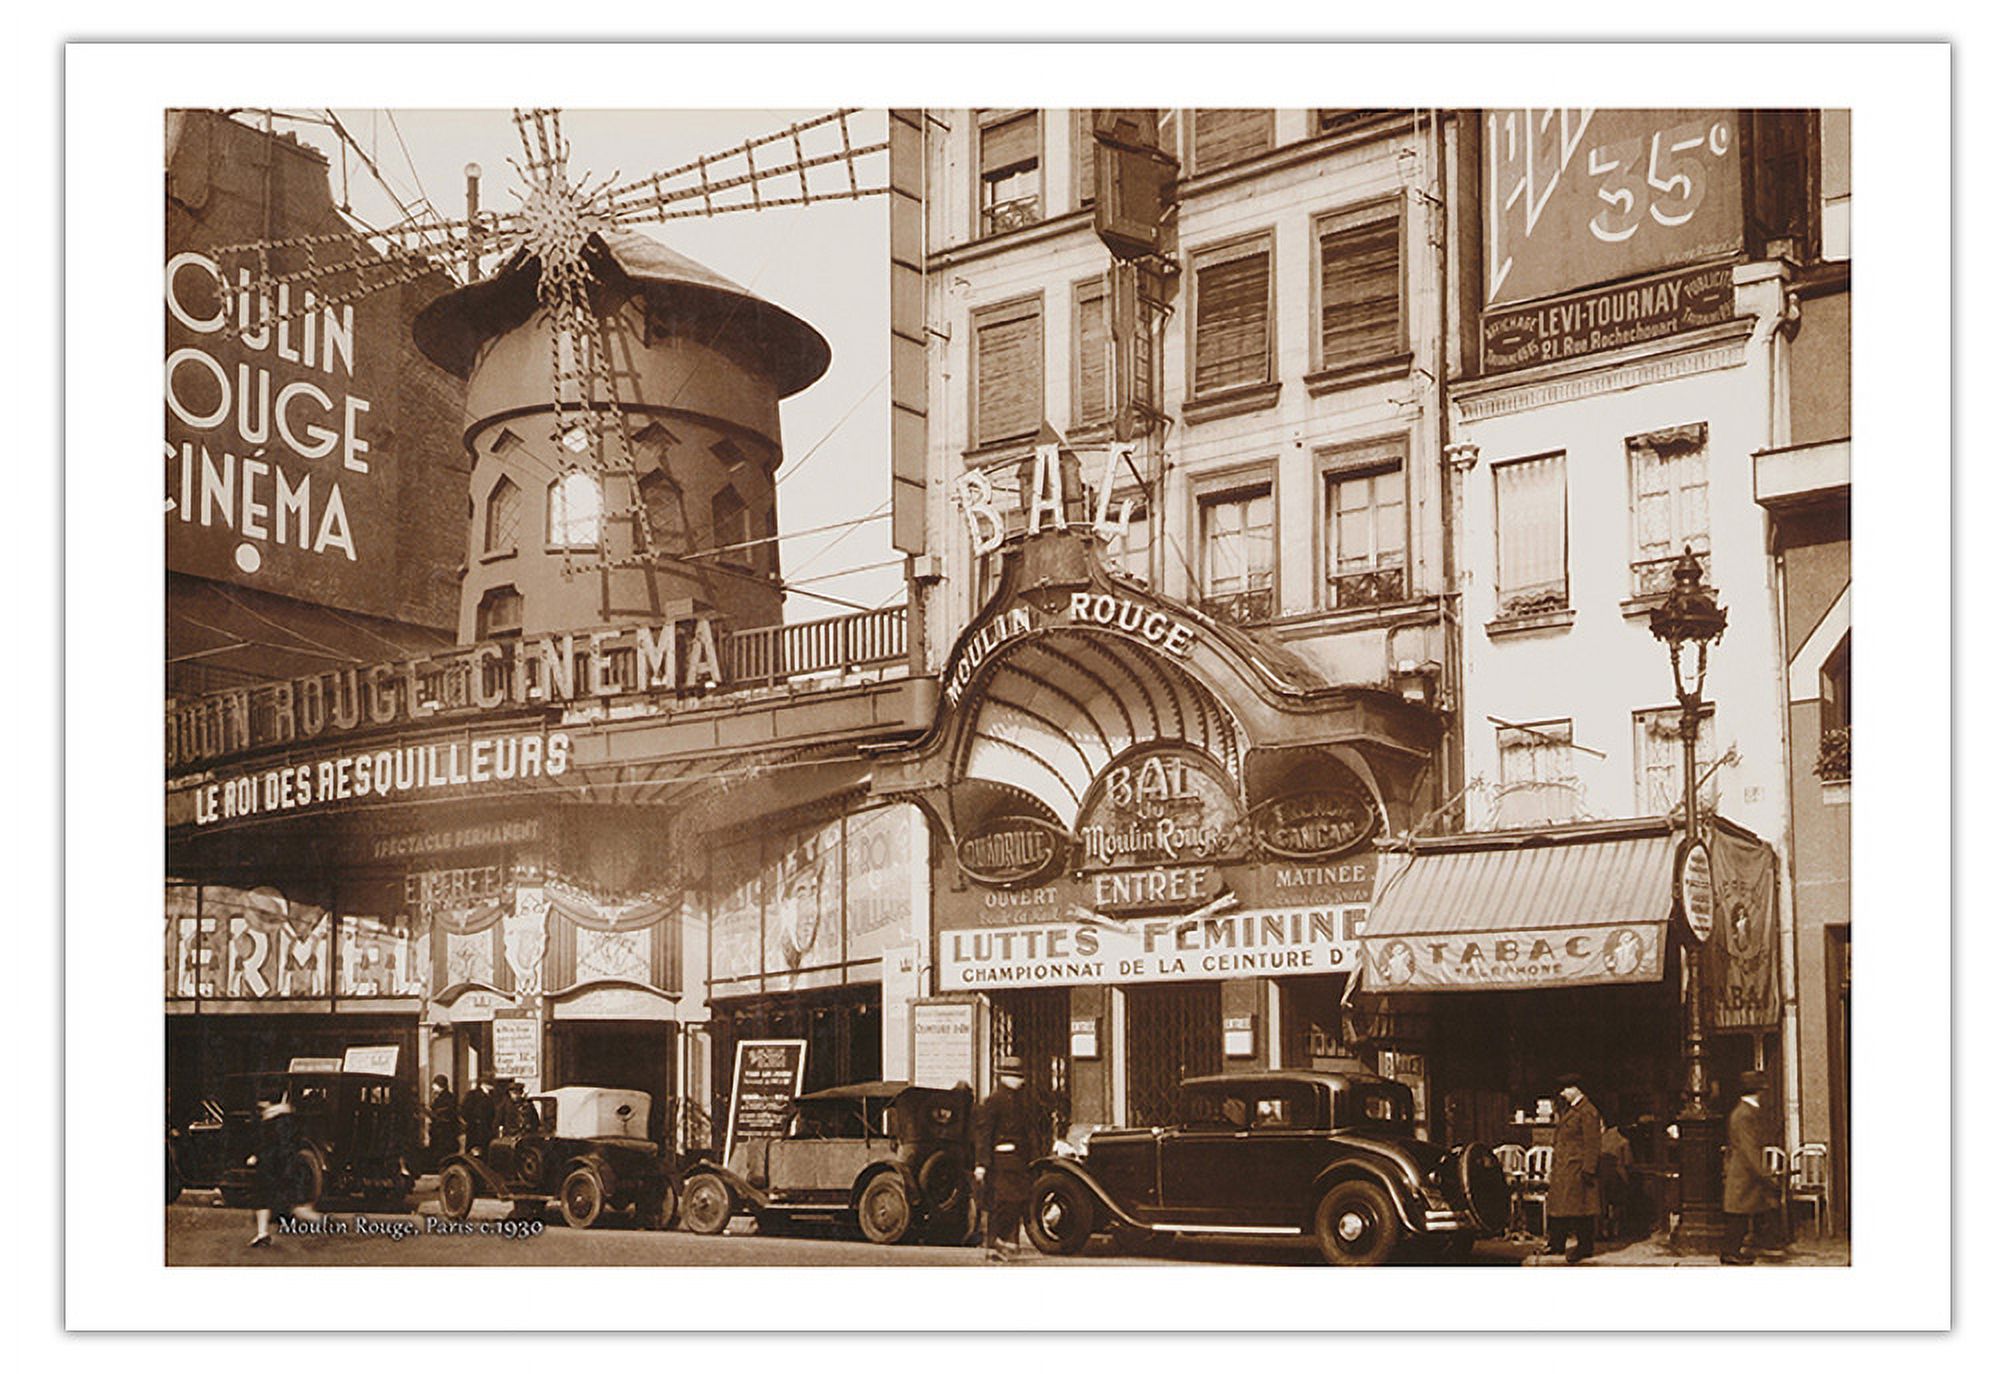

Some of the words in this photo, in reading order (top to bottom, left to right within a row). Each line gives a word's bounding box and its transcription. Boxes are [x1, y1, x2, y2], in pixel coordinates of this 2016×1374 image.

[1538, 278, 1683, 340] LEVI-TOURNAY
[951, 442, 1136, 558] BAL
[945, 606, 1031, 706] MOULIN
[1070, 592, 1196, 656] ROUGE
[274, 656, 442, 743] ROUGE
[474, 619, 722, 709] CINEMA
[195, 784, 219, 826] LE
[224, 775, 258, 818] ROI
[265, 764, 312, 809] DES
[319, 733, 570, 802] RESQUILLEURS
[1106, 756, 1200, 808] BAL
[1081, 820, 1155, 865] Moulin
[985, 887, 1058, 908] OUVERT
[953, 927, 1100, 963] LUTTES
[962, 963, 1104, 983] CHAMPIONNAT
[1119, 959, 1145, 976] DE
[1158, 957, 1186, 973] LA
[1202, 948, 1313, 972] CEINTURE
[1427, 935, 1591, 965] TABAC
